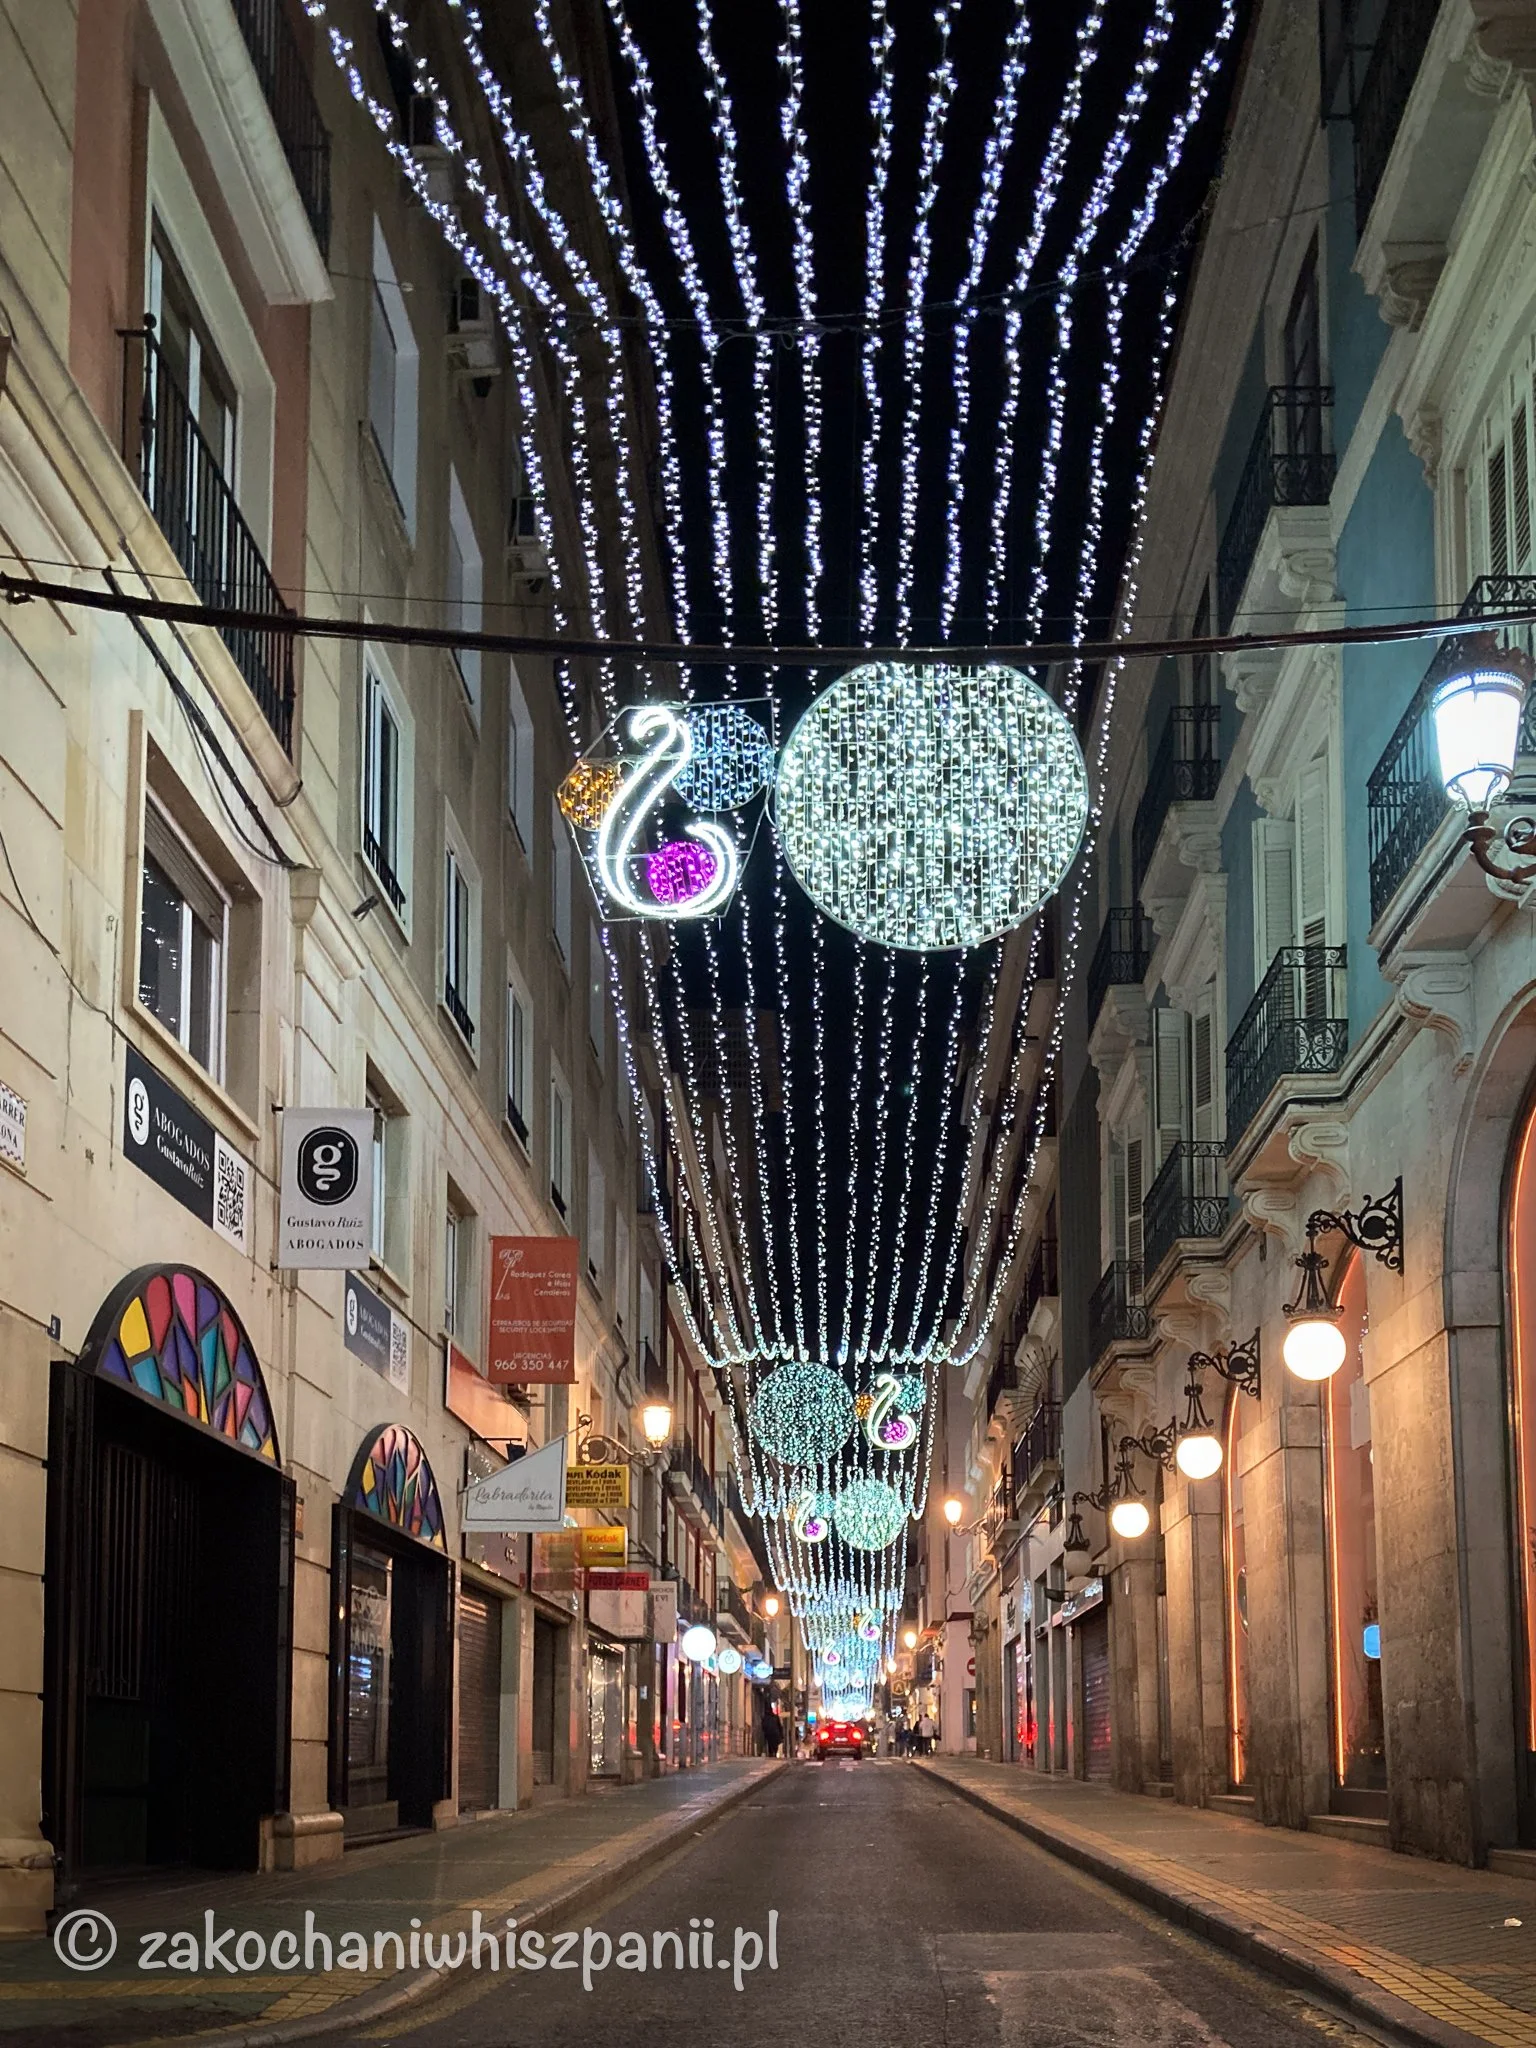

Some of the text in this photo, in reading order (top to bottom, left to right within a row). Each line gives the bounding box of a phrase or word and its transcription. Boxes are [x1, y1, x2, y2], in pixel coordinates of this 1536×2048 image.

[0, 1098, 25, 1127] RRER
[153, 1107, 210, 1172] ABOGADOS
[287, 1215, 364, 1229] Gustavo Ruiz
[286, 1239, 365, 1250] ABOGADOS
[494, 1359, 569, 1371] 966 350 447
[586, 1469, 622, 1479] Kodak
[473, 1486, 554, 1504] Labradorita
[586, 1534, 619, 1544] Kodak
